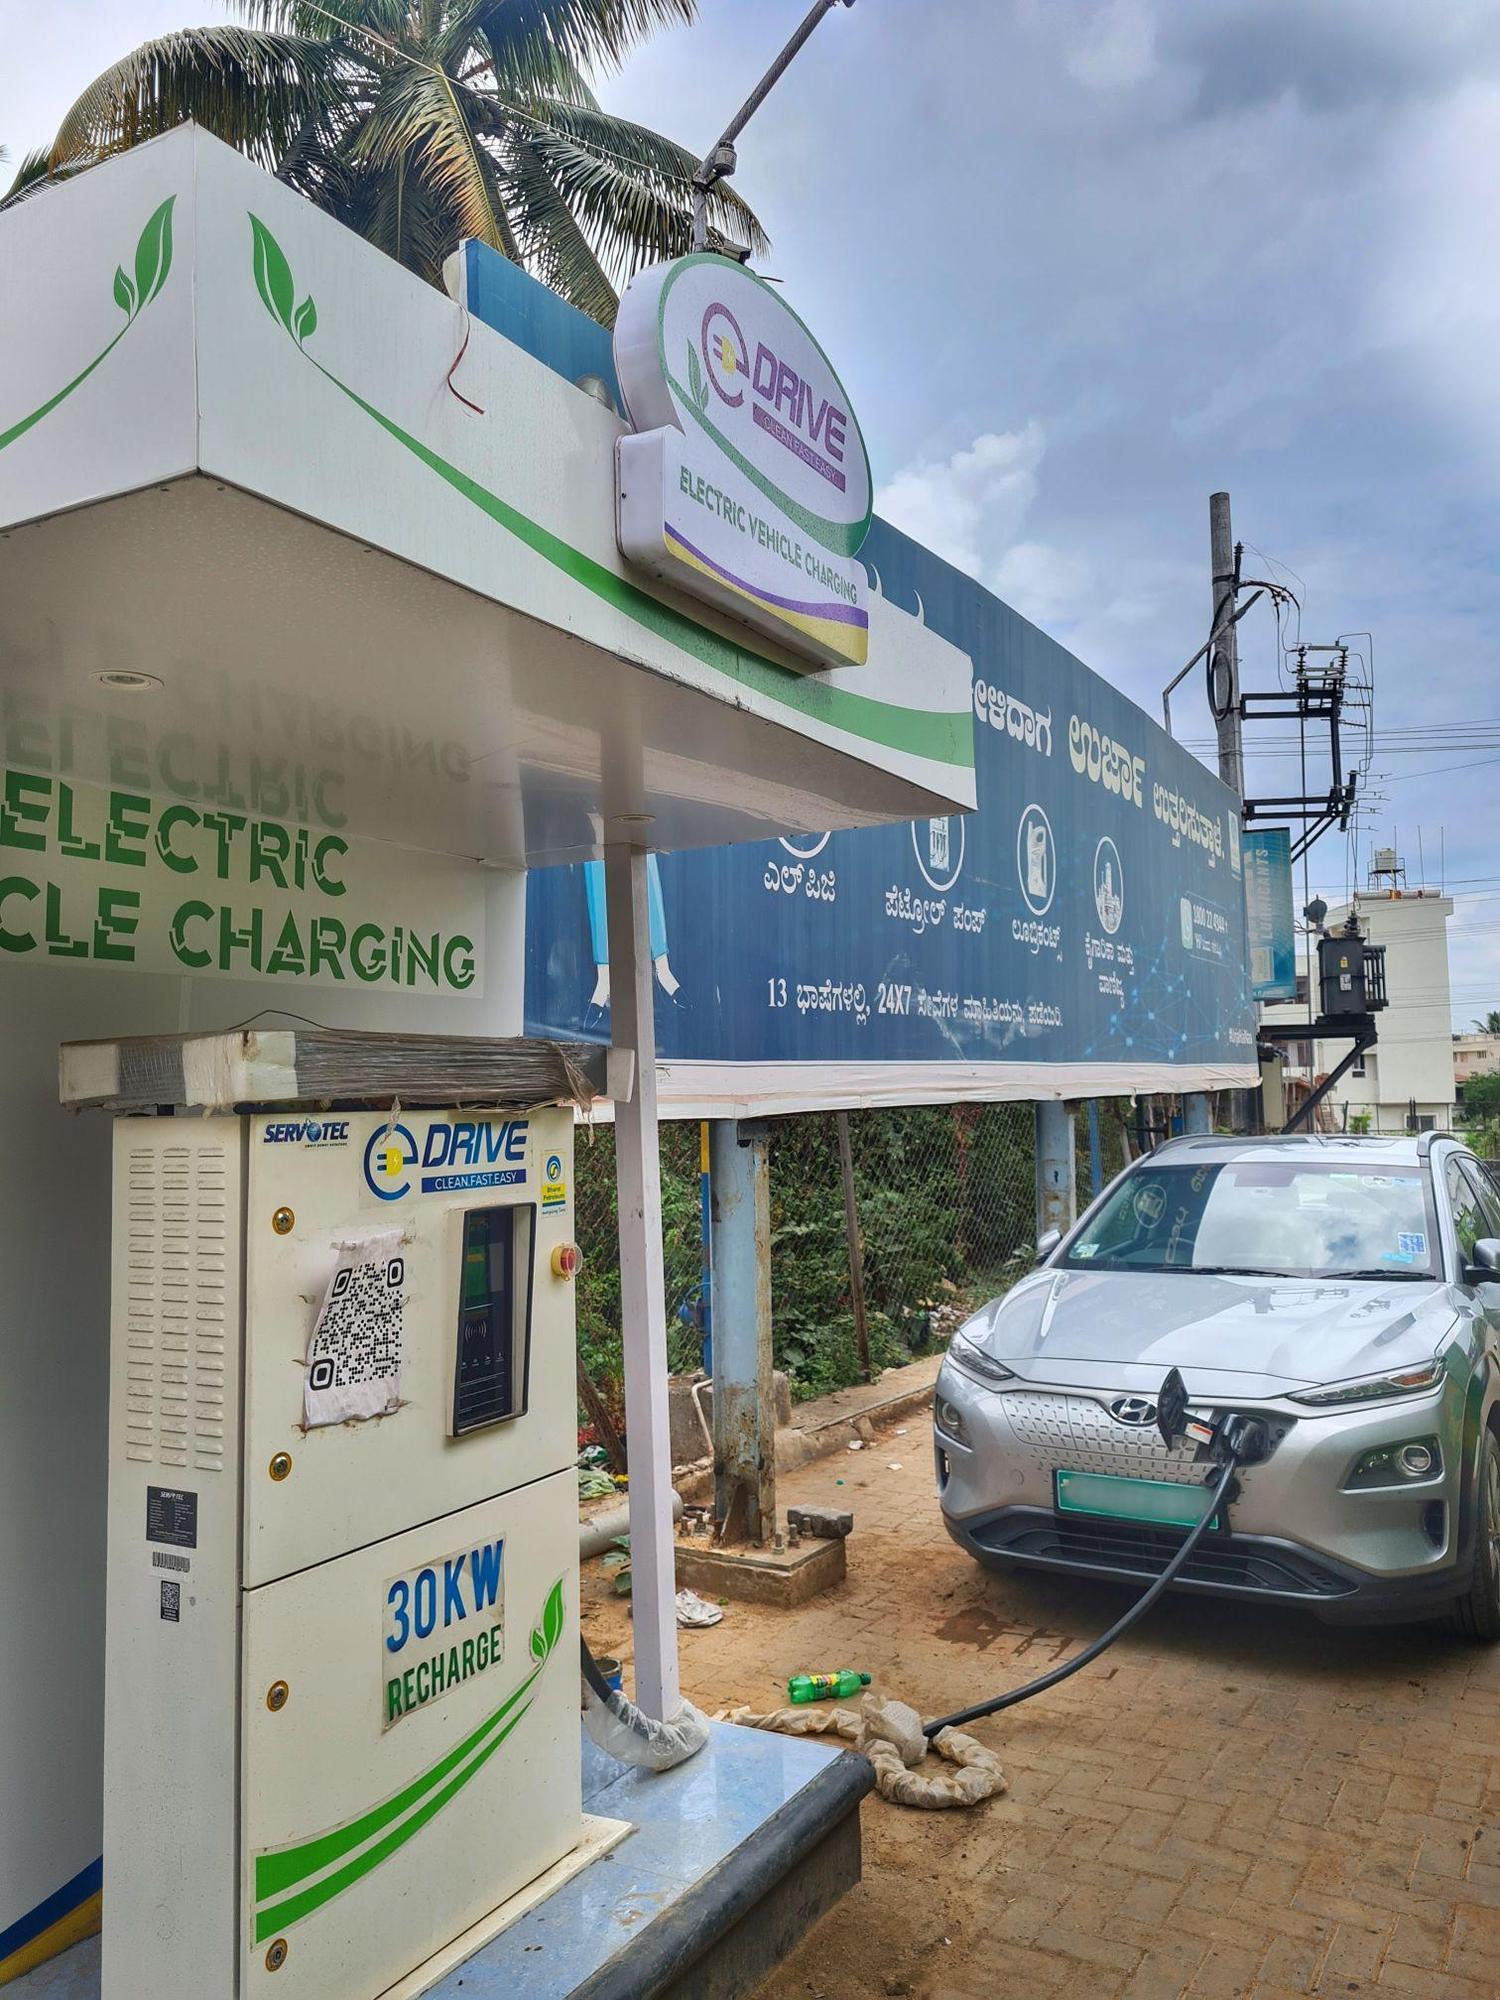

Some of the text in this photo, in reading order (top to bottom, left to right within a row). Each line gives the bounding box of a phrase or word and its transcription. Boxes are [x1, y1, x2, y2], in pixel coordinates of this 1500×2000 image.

[680, 465, 746, 533] ELECTRIC
[748, 511, 802, 569] VEHICLE
[804, 552, 858, 605] CHARGING
[0, 770, 349, 897] ELECTRIC
[169, 900, 476, 990] CHARGING
[953, 902, 986, 934] ಪಂಪ್
[767, 977, 788, 1008] 13
[877, 982, 912, 1015] 24X7
[421, 1119, 530, 1169] DRIVE
[386, 1539, 504, 1653] 30KW
[387, 1623, 502, 1722] RECHARGE
